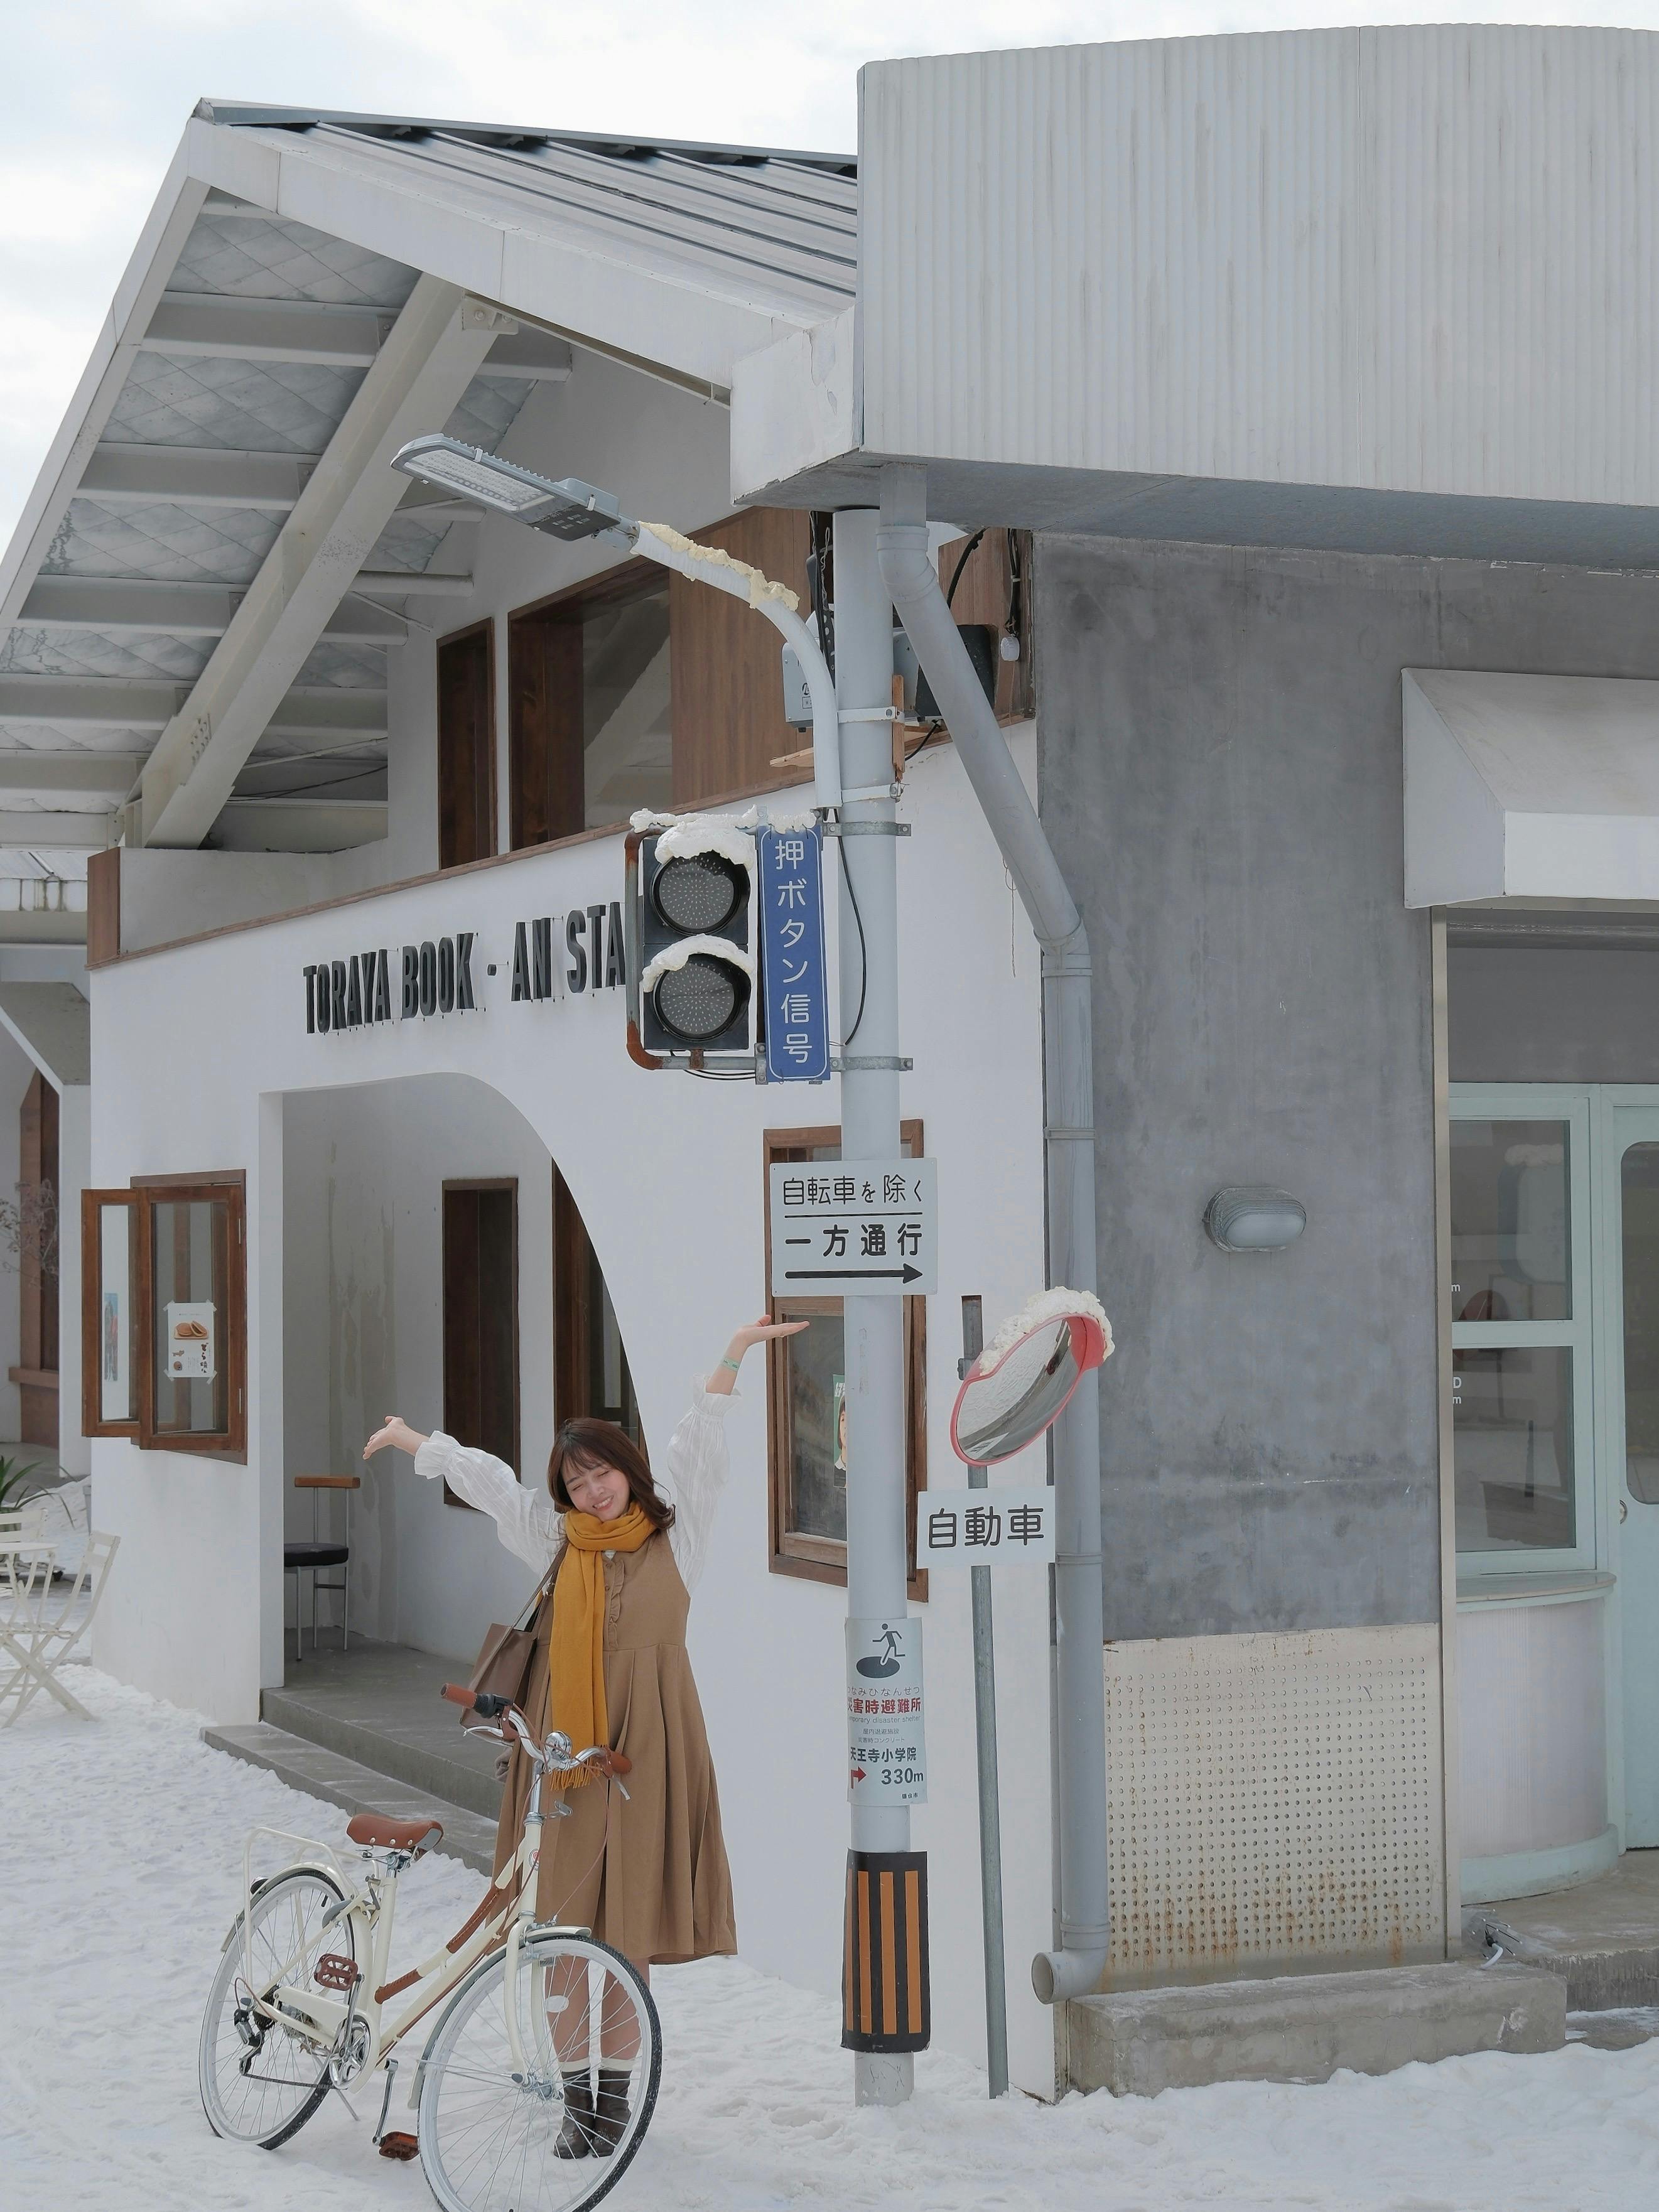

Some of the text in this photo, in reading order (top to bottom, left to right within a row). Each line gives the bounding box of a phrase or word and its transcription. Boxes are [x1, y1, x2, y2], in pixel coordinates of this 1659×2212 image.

[303, 949, 391, 1033] TORAYA
[401, 932, 475, 1019] BOOK
[511, 917, 552, 1001] AN
[566, 902, 627, 993] STA
[775, 839, 813, 1064] 押ボタン信号
[783, 1173, 922, 1206] 自転車を除く
[785, 1222, 922, 1257] 一方通行
[928, 1504, 1044, 1549] 自動車
[850, 1747, 917, 1762] 天王寺小学院
[881, 1767, 924, 1785] 330m
